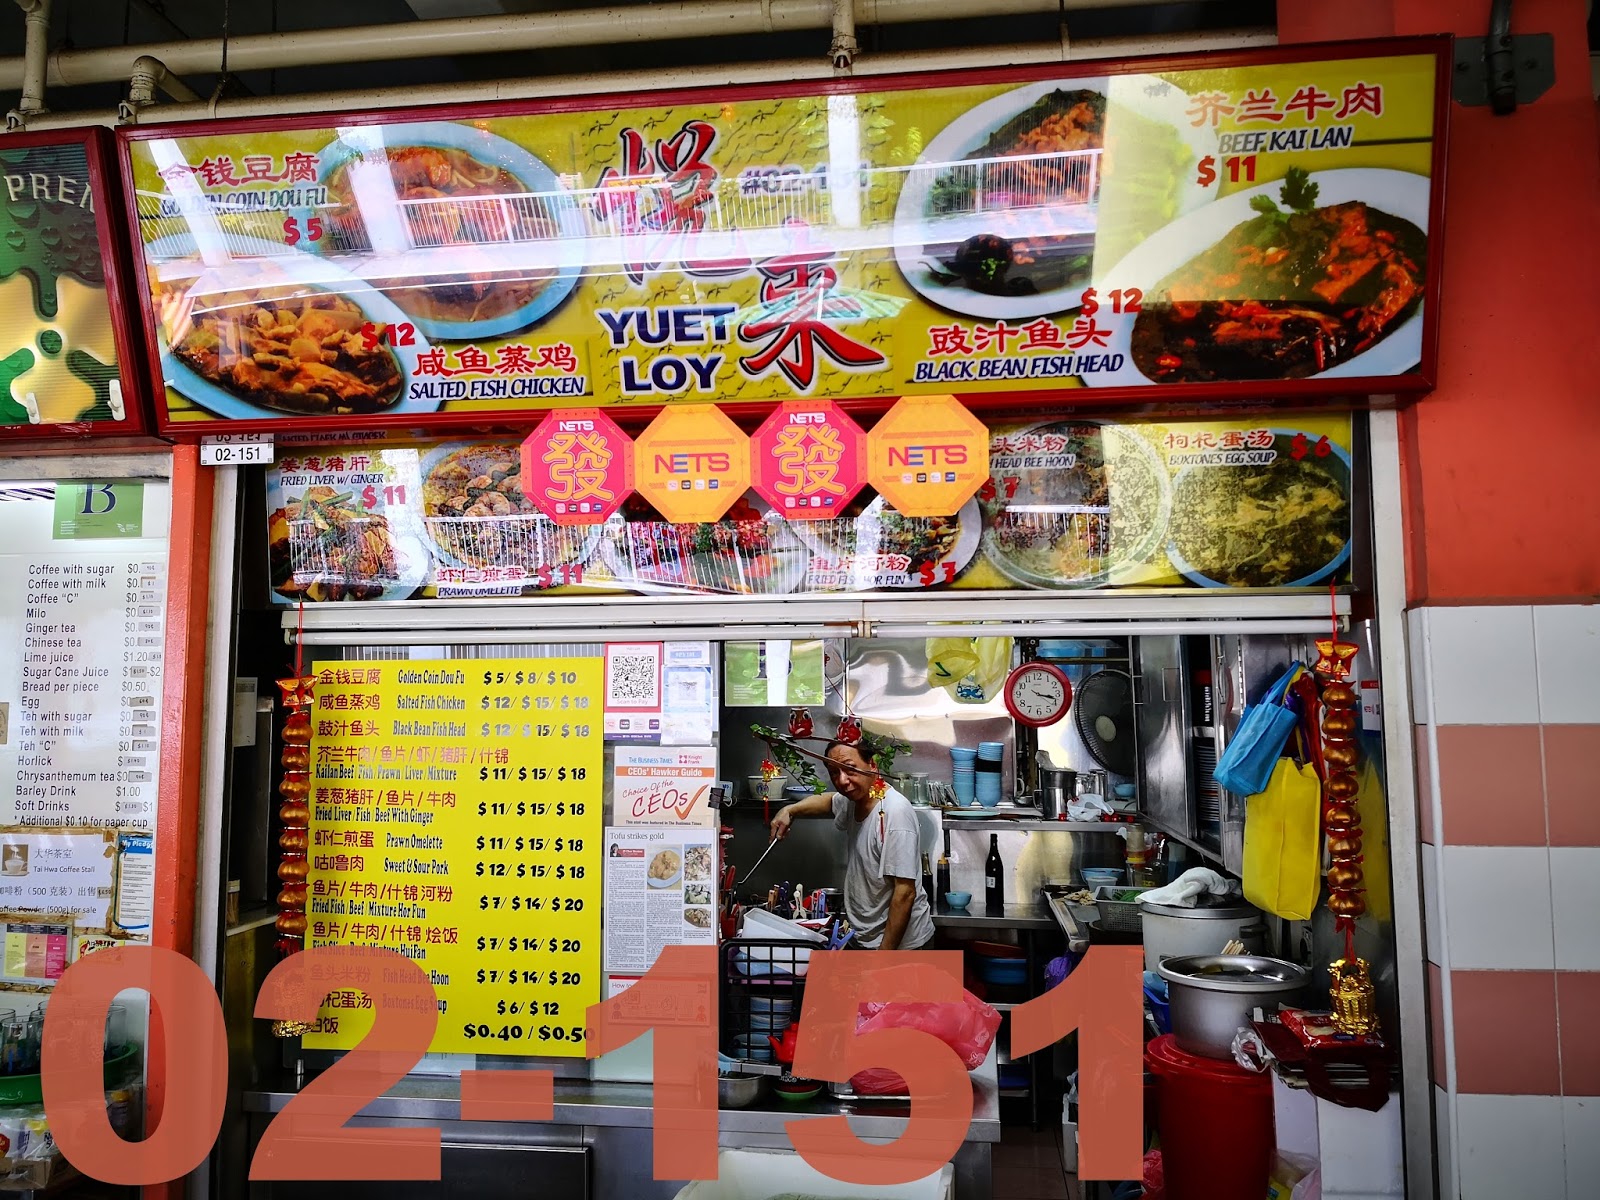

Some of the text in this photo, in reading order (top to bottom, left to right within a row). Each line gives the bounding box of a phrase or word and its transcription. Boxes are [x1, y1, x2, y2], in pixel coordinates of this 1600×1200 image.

[1185, 83, 1381, 127] 芥兰牛肉
[1219, 126, 1353, 154] BEEF KAI LAN
[269, 189, 302, 208] DOU
[305, 187, 326, 207] FU
[599, 307, 734, 344] YUET
[928, 317, 1113, 355] 豉汁鱼头
[412, 343, 577, 377] 咸鱼蒸鸡
[916, 352, 1125, 381] BLACK BEAN FISH HEAD
[624, 356, 722, 392] LOY
[409, 377, 585, 400] SALTED FISH CHICKEN
[559, 420, 594, 432] NETS
[789, 412, 826, 424] NETS
[989, 434, 1067, 454] 头米粉
[1164, 430, 1274, 449] 枸杞蛋汤
[215, 447, 261, 462] 02-151
[772, 423, 846, 495] 發
[888, 444, 968, 467] NETS
[995, 455, 1074, 469] HEAD BEE HOON
[1169, 451, 1275, 465] BOXTONES EGG SOUP
[279, 456, 371, 473] 姜葱猪肝
[542, 431, 614, 501] 發
[655, 453, 730, 474] NETS
[280, 475, 307, 486] FRIED
[309, 474, 335, 486] LIVER
[350, 473, 384, 485] GINGER
[28, 563, 115, 576] Coffee with sugar
[885, 575, 906, 585] FUN
[27, 593, 58, 604] Coffee
[438, 586, 473, 597] PRAWN
[26, 608, 46, 618] Milo
[25, 622, 76, 635] Ginger tea
[25, 637, 82, 648] Chinese tea
[24, 652, 47, 662] Lime
[49, 652, 74, 665] juice
[23, 666, 109, 679] Sugar Cane Juice
[319, 668, 381, 685] 金钱豆腐
[398, 669, 465, 685] Golden Coin Dou Fu
[22, 681, 146, 694] Bread per piece $0.50
[22, 696, 40, 708] Egg
[319, 693, 380, 711] 咸鱼蒸鸡
[397, 694, 466, 710] Salted Fish Chicken
[393, 720, 466, 737] Black Bean Fish Head
[19, 741, 36, 751] Teh
[18, 755, 52, 766] Horlick
[17, 770, 115, 783] Chrysanthemum tea
[650, 768, 680, 776] Hawker
[680, 768, 703, 777] Guide
[16, 785, 141, 798] Barley Drink $1.00
[622, 779, 674, 798] Choice Of the
[14, 800, 70, 811] Soft Drinks
[632, 789, 688, 817] CEOs
[19, 815, 148, 829] Additional $0.10 for paper cup
[314, 829, 375, 848] 虾仁煎蛋
[386, 832, 443, 849] Prawn Omelette
[609, 832, 665, 842] Tofu strikes gold
[33, 865, 96, 873] Tai Hwa Coffee Stall
[384, 857, 449, 875] Sweet & Sour Pork
[431, 969, 450, 985] Hoon
[463, 1023, 523, 1041] $0.40
